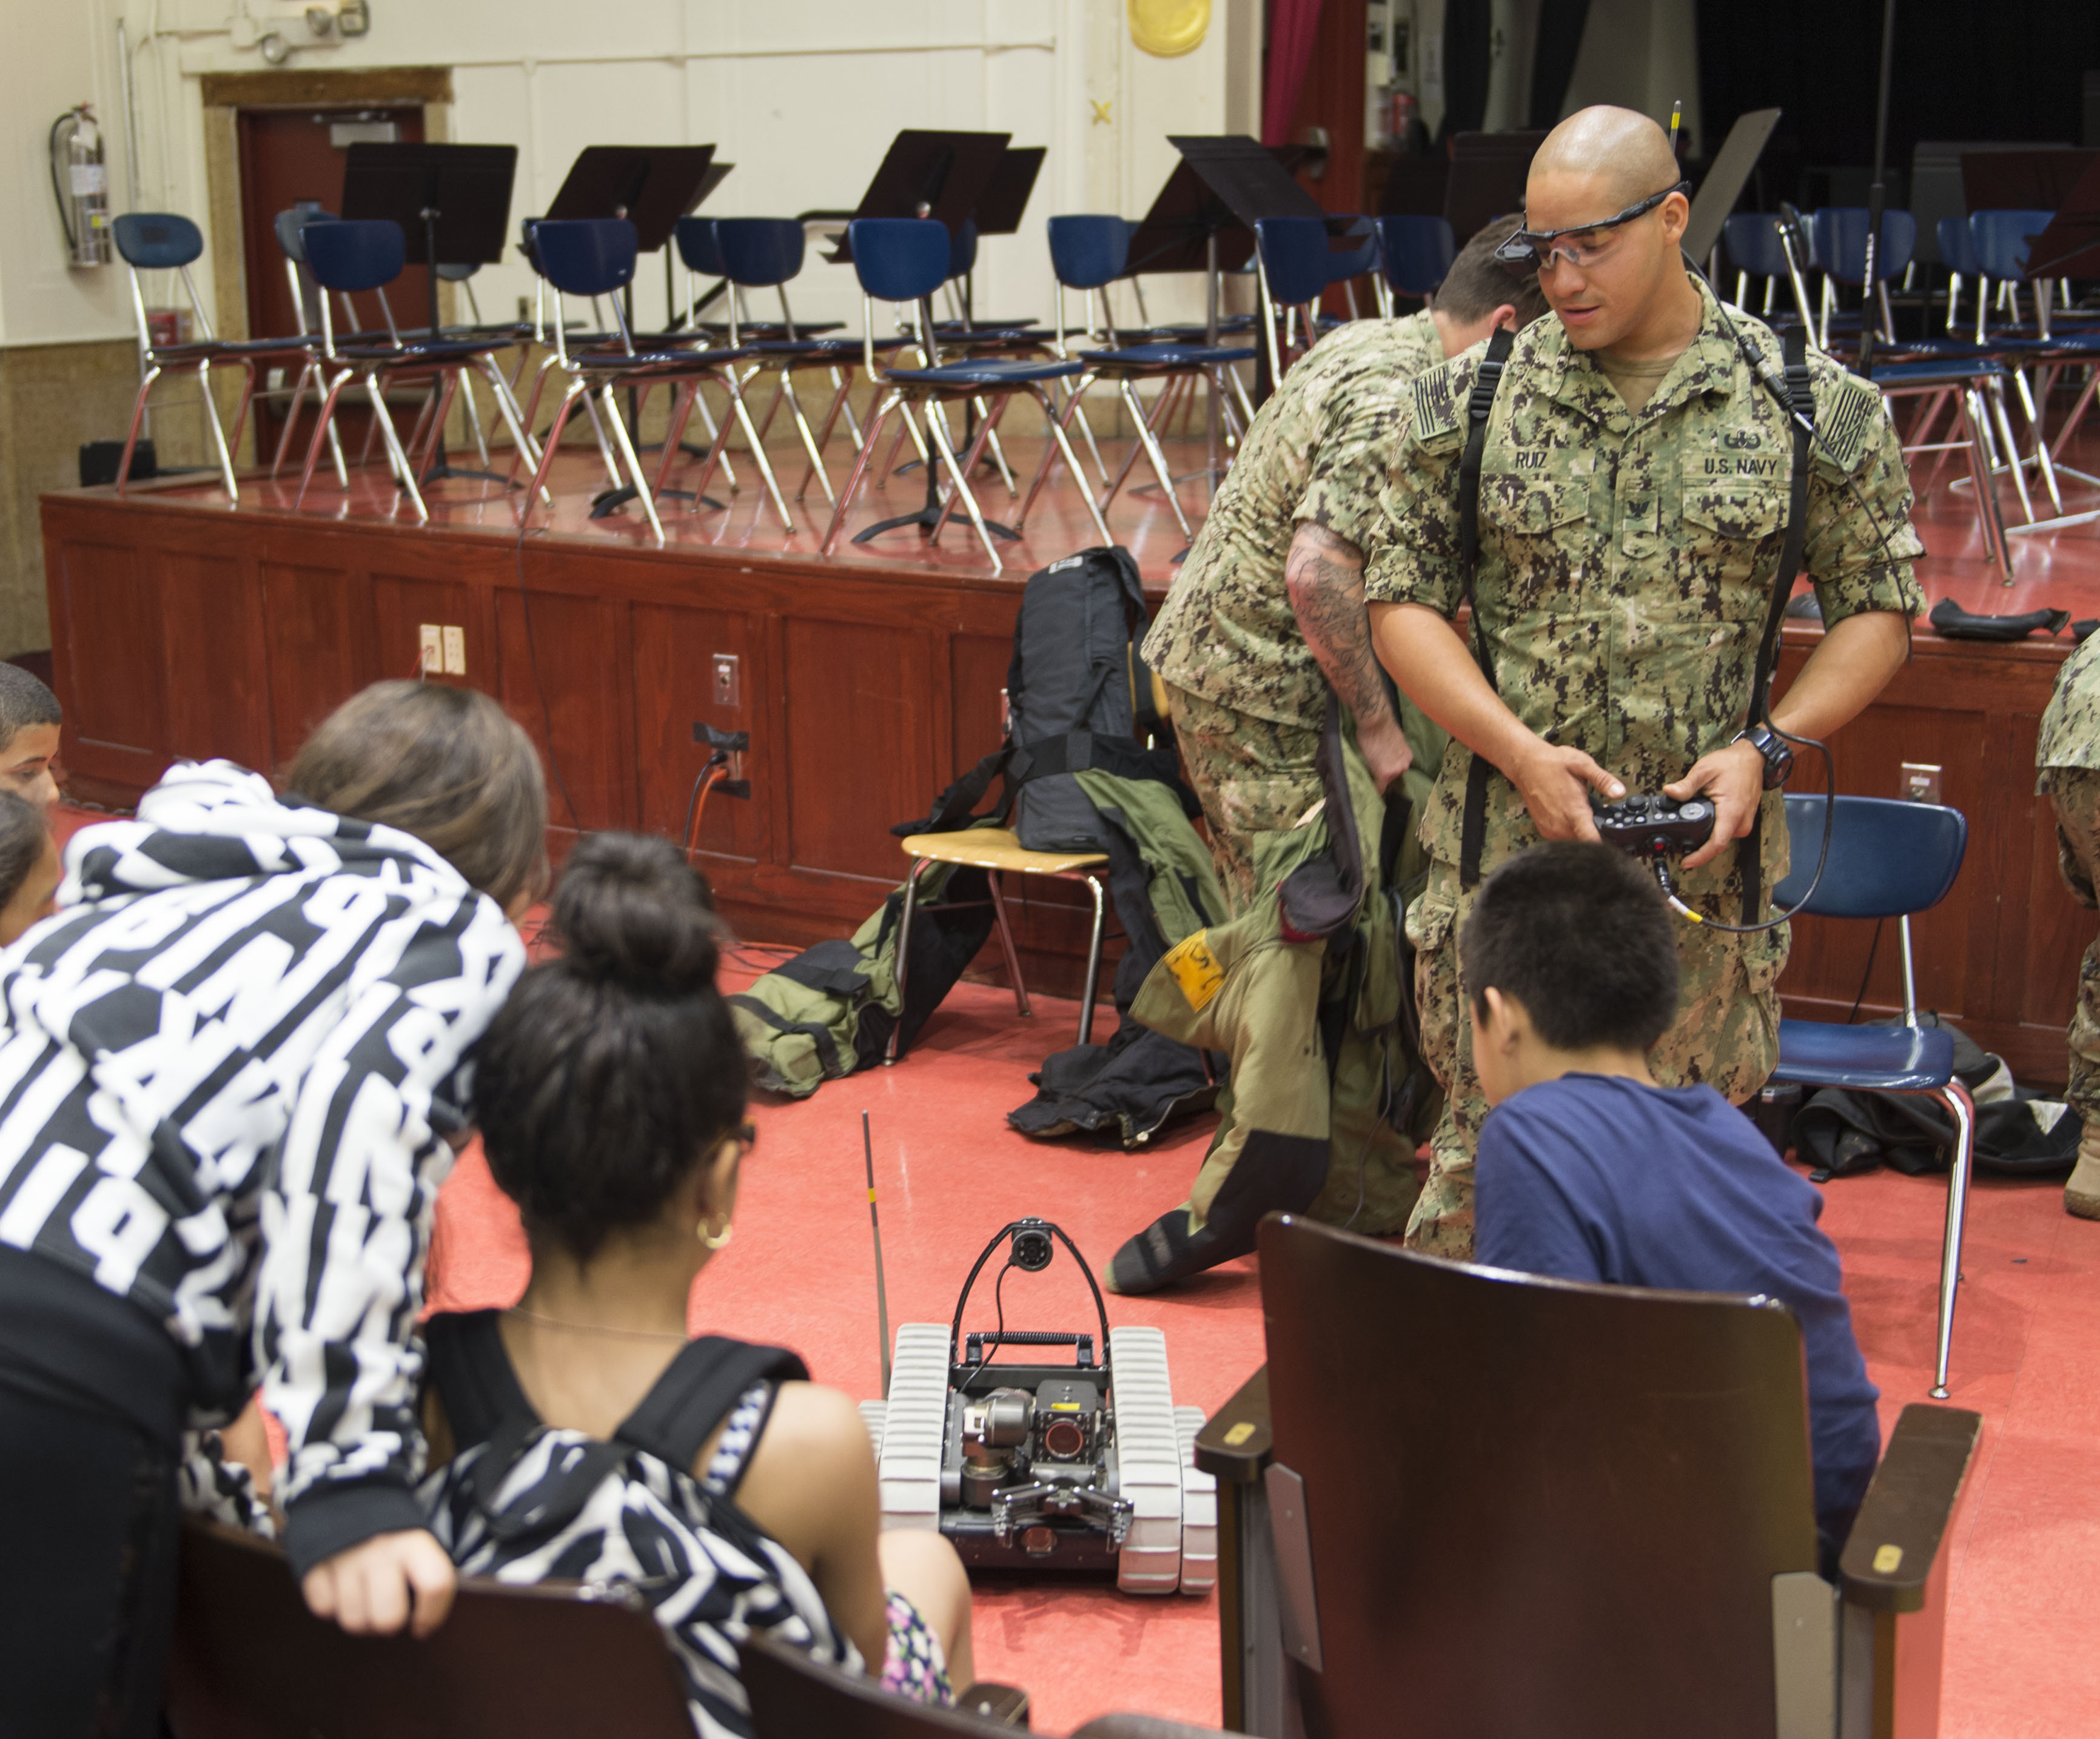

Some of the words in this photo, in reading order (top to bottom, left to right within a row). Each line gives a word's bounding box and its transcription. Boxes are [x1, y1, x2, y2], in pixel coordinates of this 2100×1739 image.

[1515, 451, 1548, 469] RUIZ
[1705, 458, 1733, 474] U.S.
[1737, 459, 1777, 475] NAVY
